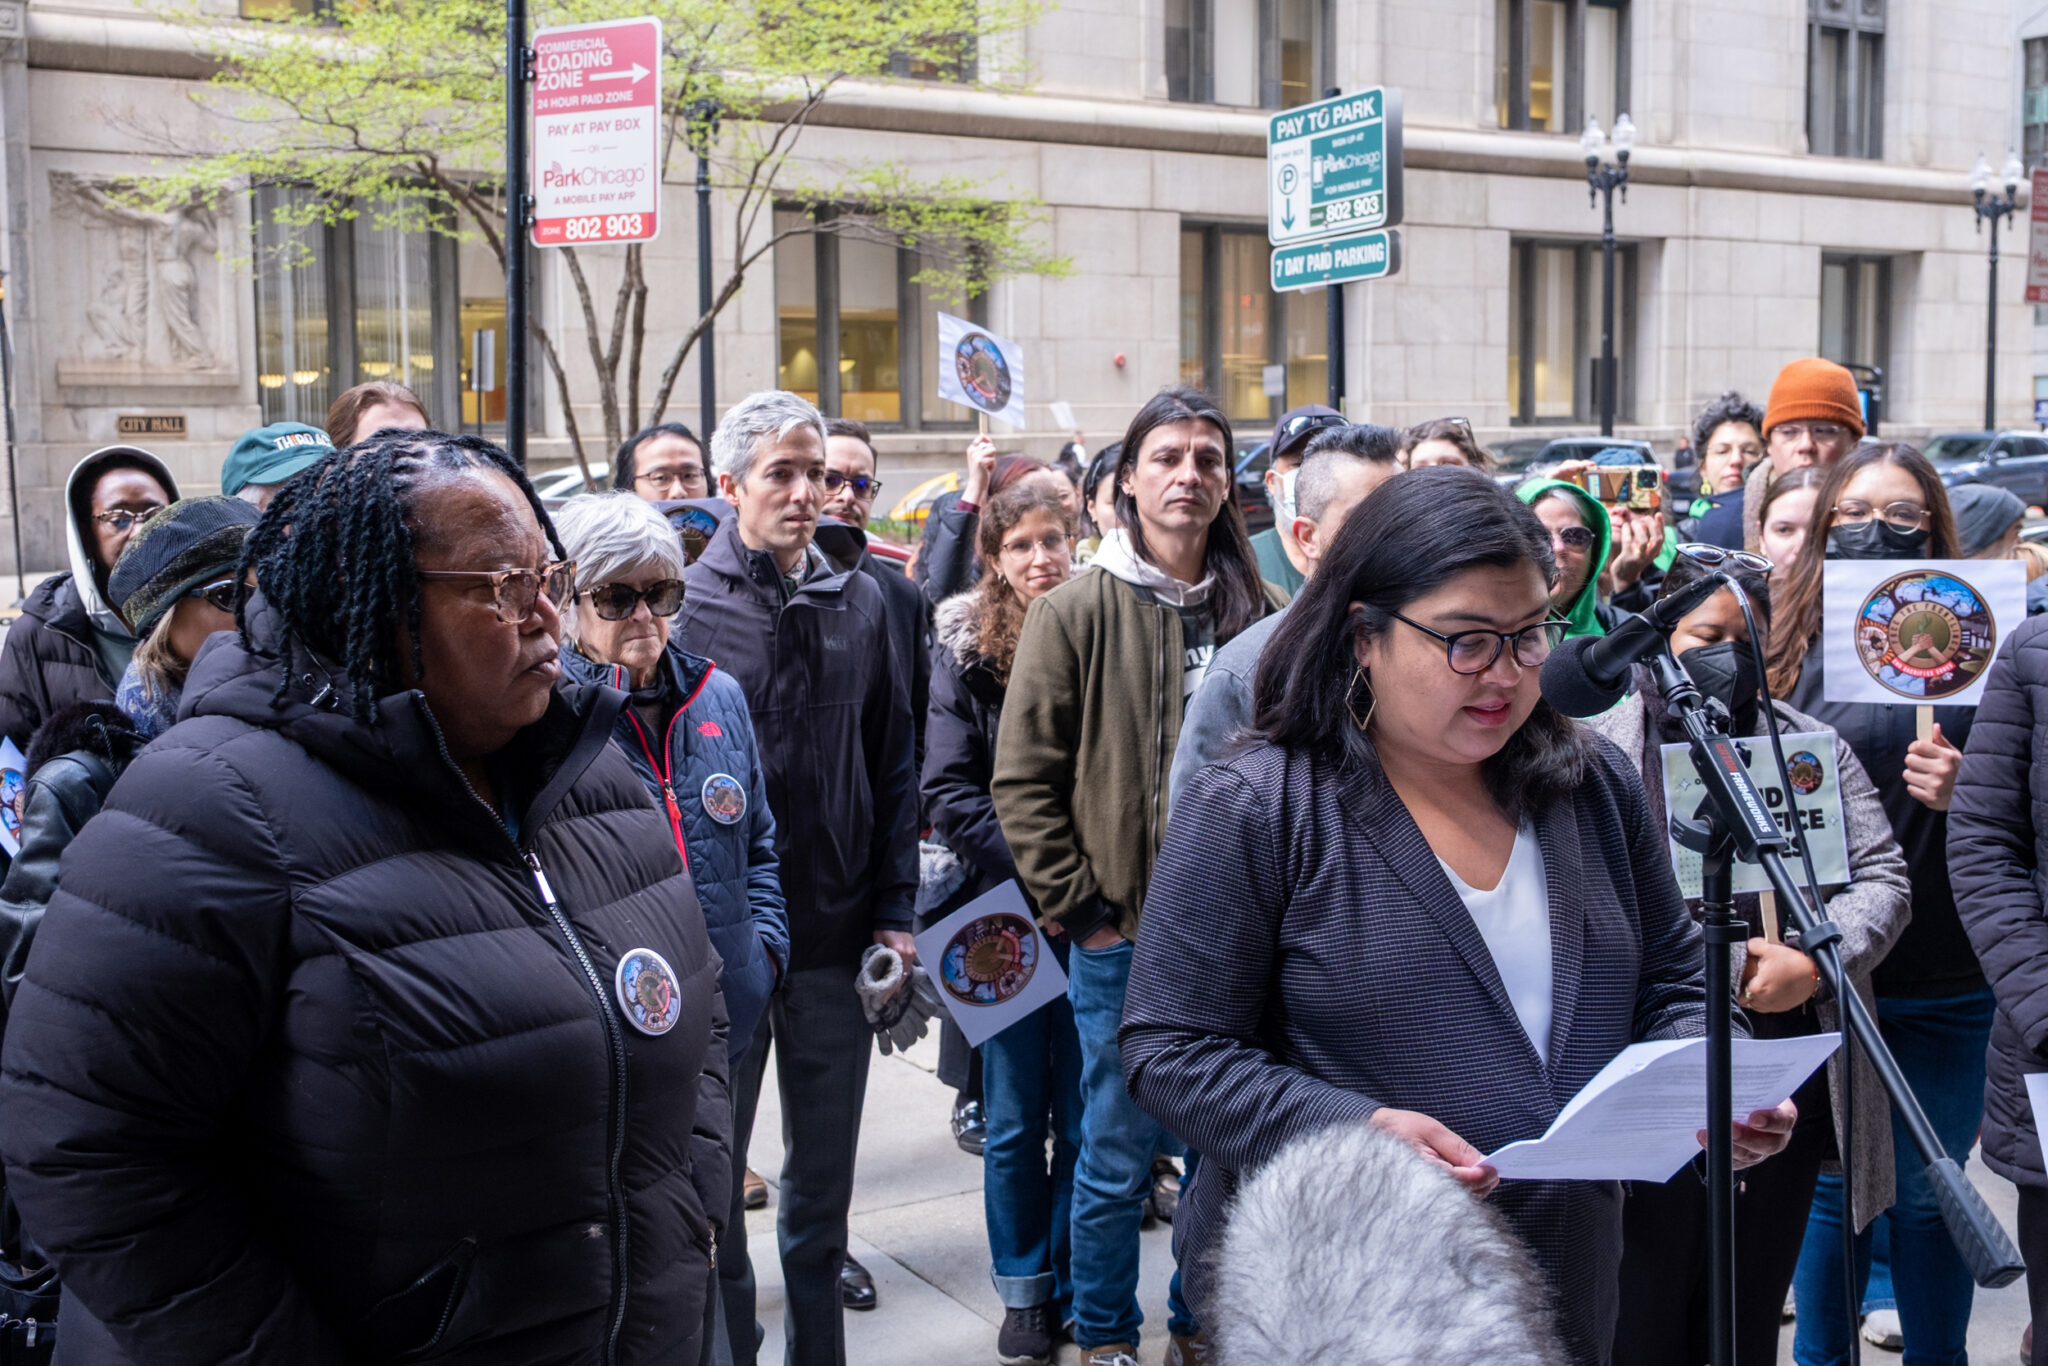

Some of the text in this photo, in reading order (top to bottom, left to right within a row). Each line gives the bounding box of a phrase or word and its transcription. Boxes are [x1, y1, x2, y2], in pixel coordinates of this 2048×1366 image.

[538, 37, 608, 55] COMMERCIAL
[538, 49, 613, 73] LOADING
[537, 71, 583, 91] ZONE
[537, 90, 634, 110] 24 HOUR PAID ZONE
[548, 117, 641, 137] PAY AT PAY BOX
[1276, 96, 1376, 140] PAY TO PARK
[543, 164, 645, 189] ParkChicago
[554, 190, 637, 205] A MOBILE PAY APP
[1326, 201, 1352, 222] 802
[1353, 196, 1379, 217] 903
[565, 217, 602, 240] 802
[606, 213, 643, 237] 903
[1275, 242, 1385, 277] 7 DAY PAID PARKING
[119, 417, 183, 432] CITY HALL
[273, 432, 315, 451] THIRD
[1730, 771, 1773, 833] FRAMEWORKS
